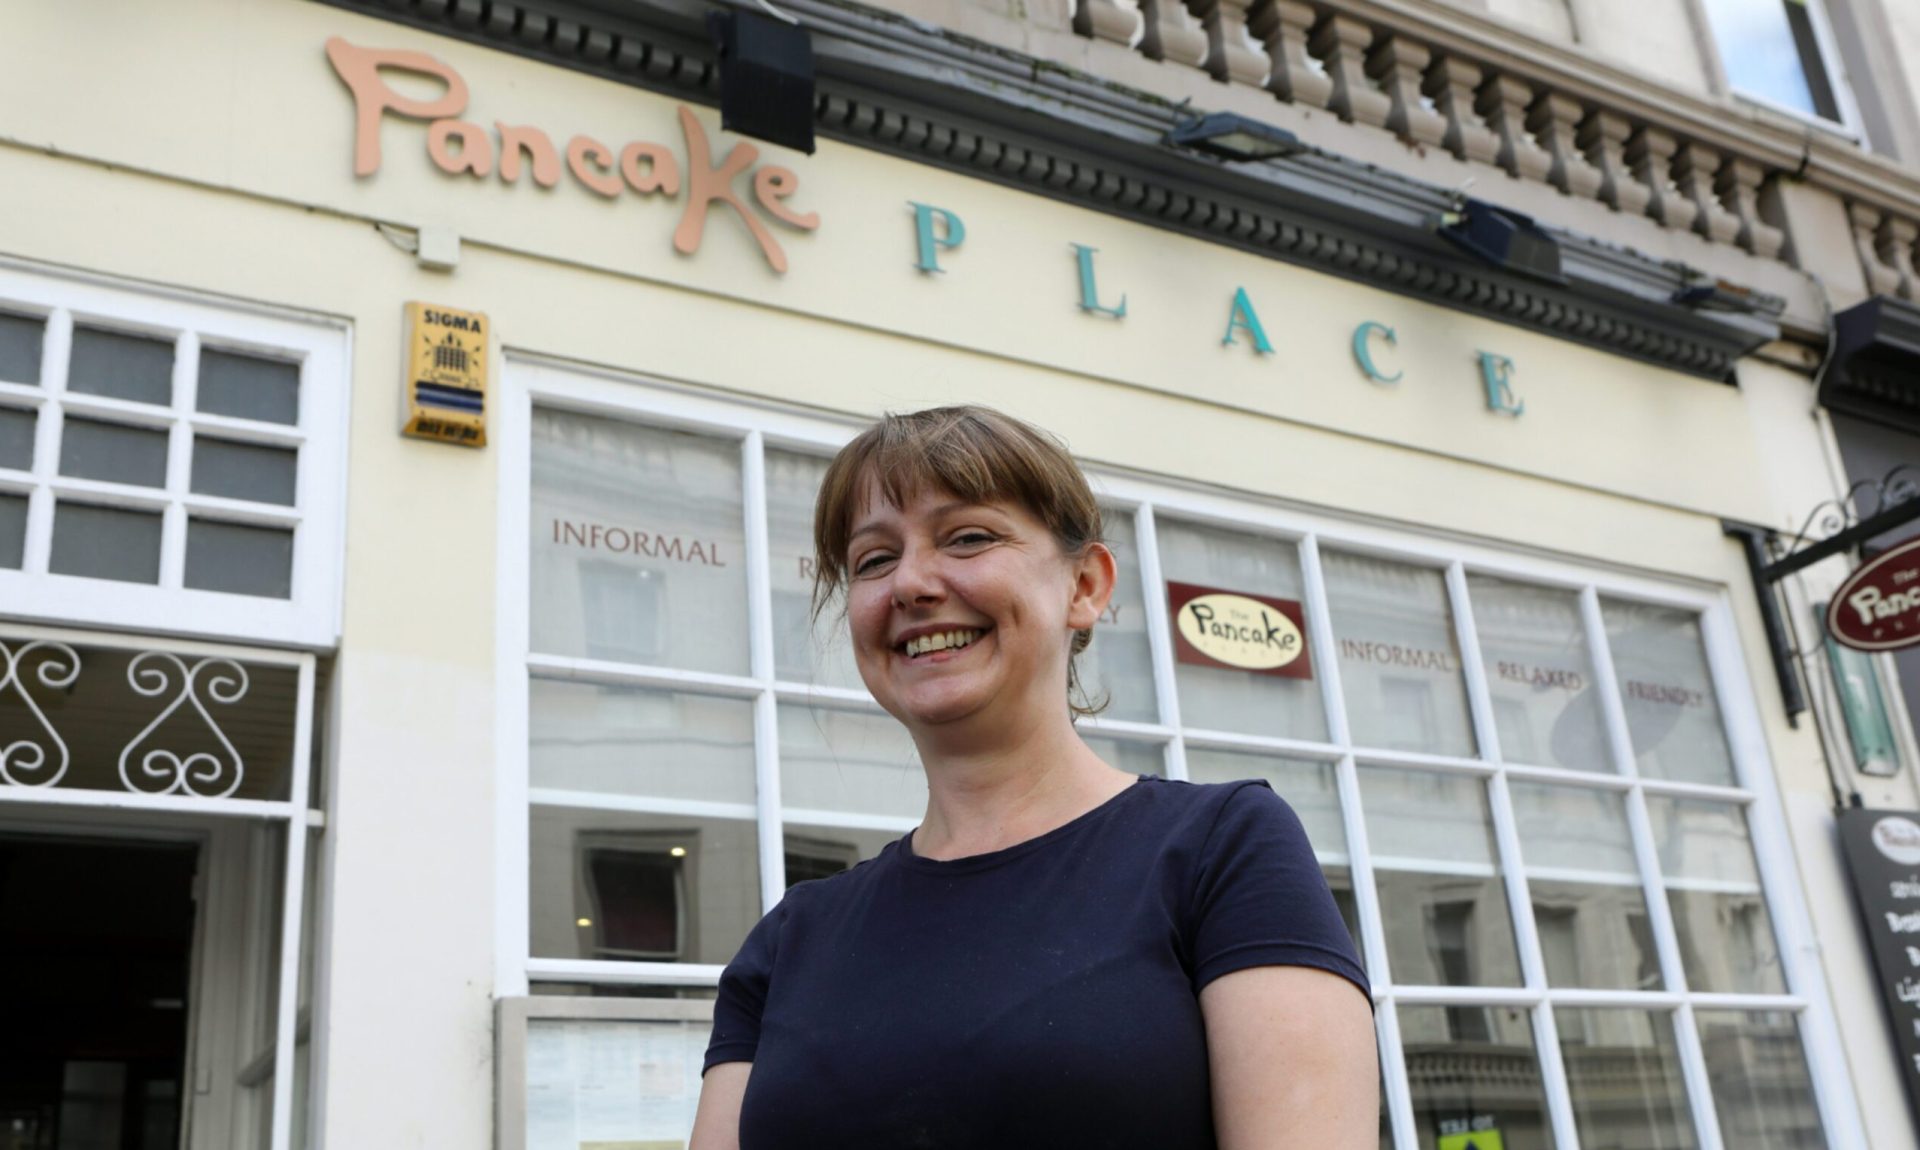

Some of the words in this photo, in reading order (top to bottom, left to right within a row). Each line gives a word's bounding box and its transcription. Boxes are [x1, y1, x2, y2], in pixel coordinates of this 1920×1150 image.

[325, 35, 820, 273] Pancake
[424, 310, 481, 333] SIGMA
[553, 519, 726, 567] INFORMAL
[1190, 604, 1295, 650] Pancake
[1341, 639, 1454, 673] INFORMAL
[1497, 661, 1583, 690] RELAXED
[1626, 680, 1703, 707] FRIENDLY
